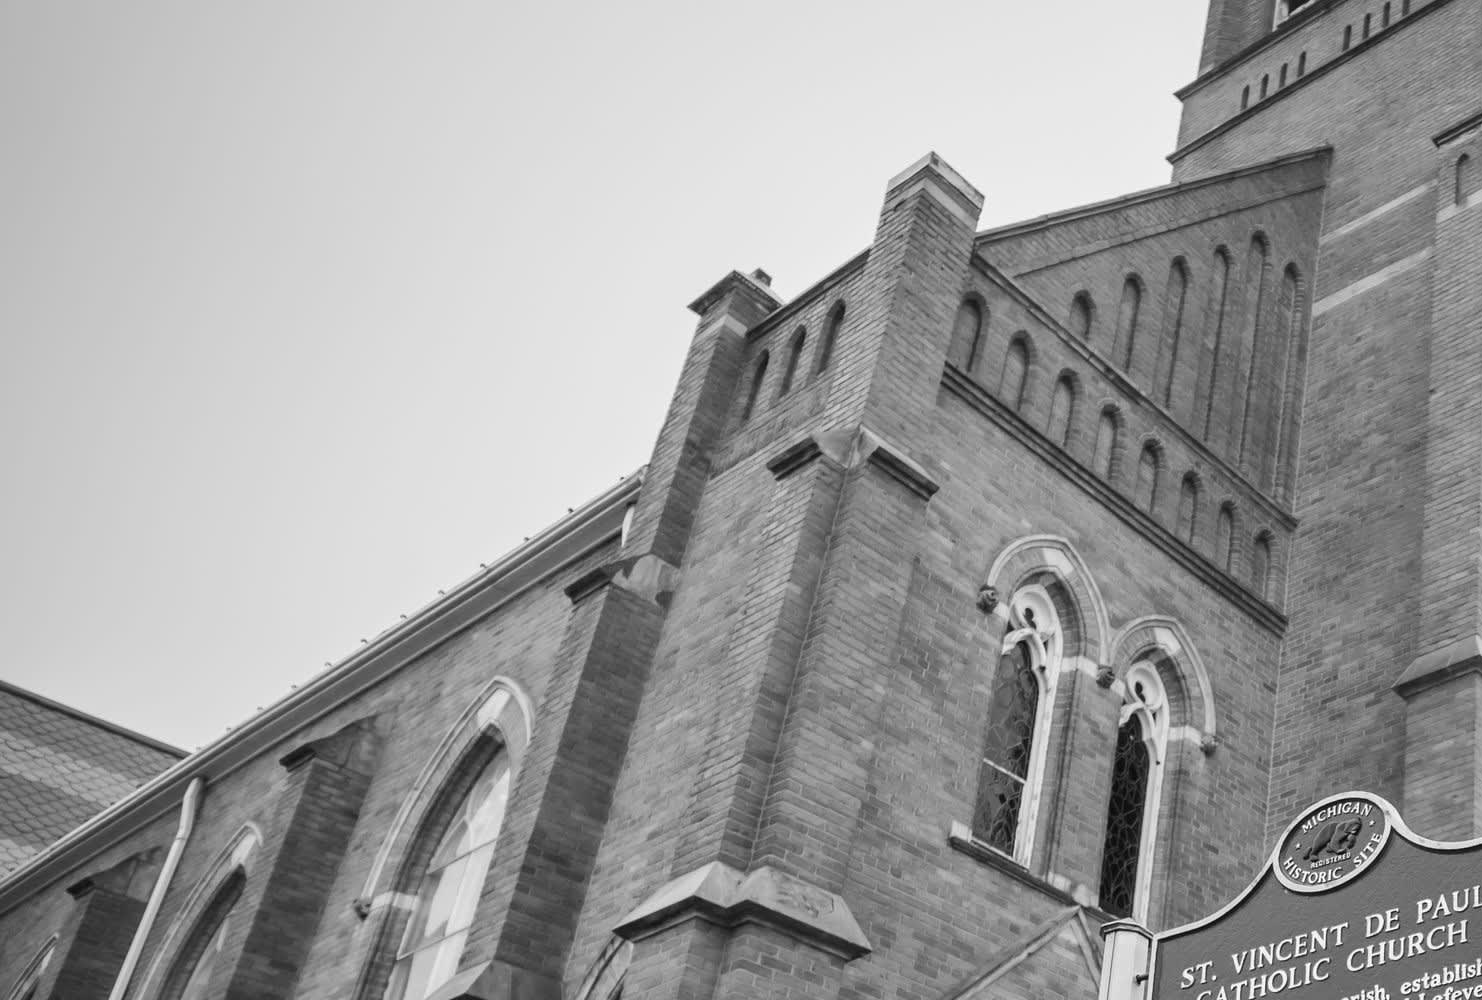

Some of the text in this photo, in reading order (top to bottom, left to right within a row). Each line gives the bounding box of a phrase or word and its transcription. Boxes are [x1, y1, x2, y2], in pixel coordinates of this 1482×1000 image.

[1302, 801, 1373, 834] MICHIGAN
[1283, 832, 1383, 884] HISTORIC SITE
[1310, 852, 1351, 869] REGISTERED
[1180, 960, 1217, 989] ST.
[1231, 921, 1349, 974] VINCENT
[1364, 907, 1400, 938] DE
[1346, 919, 1468, 972] CHURCH
